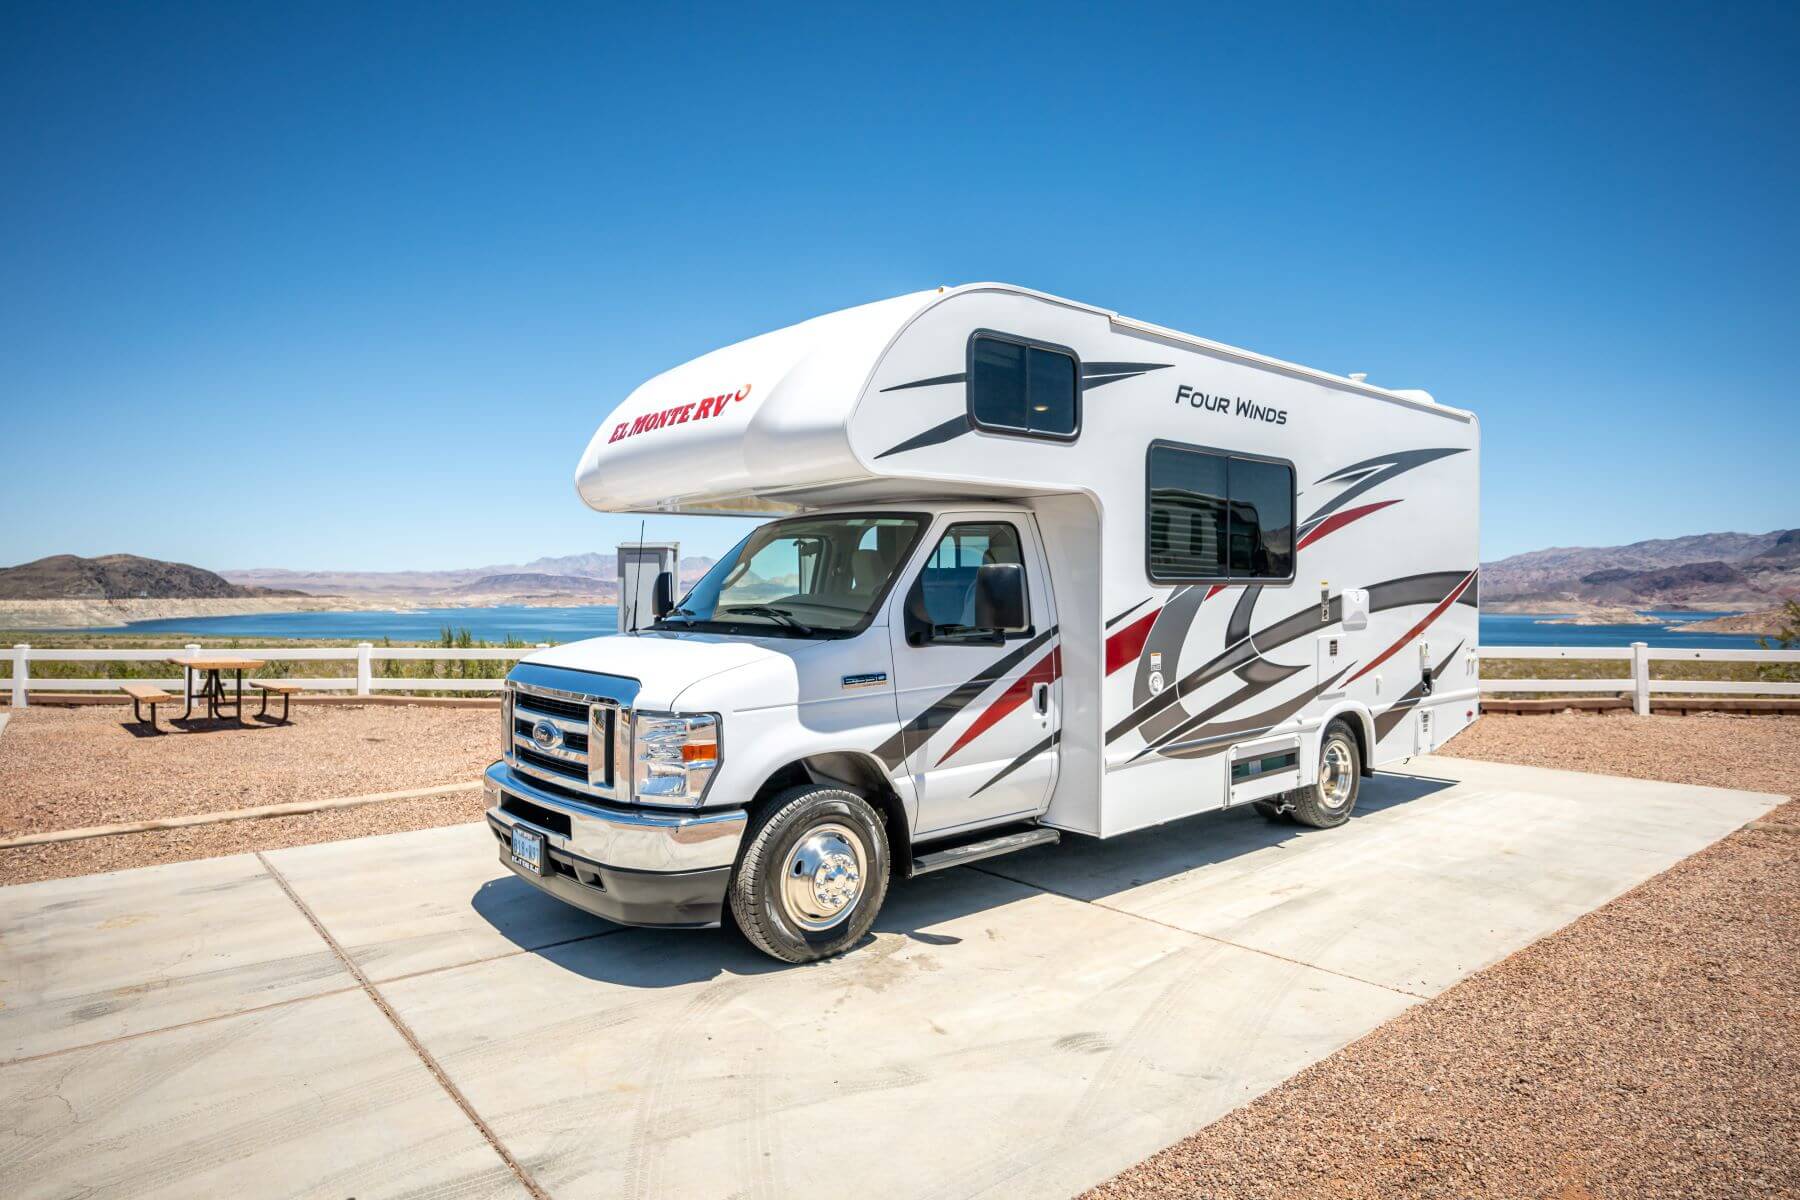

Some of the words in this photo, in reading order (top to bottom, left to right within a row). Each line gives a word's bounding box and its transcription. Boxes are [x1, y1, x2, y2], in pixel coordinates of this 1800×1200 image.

[608, 422, 630, 444] EL
[627, 402, 697, 437] MONTE
[692, 393, 733, 421] RV
[1175, 384, 1231, 414] FOUR
[1235, 396, 1288, 425] WINDS
